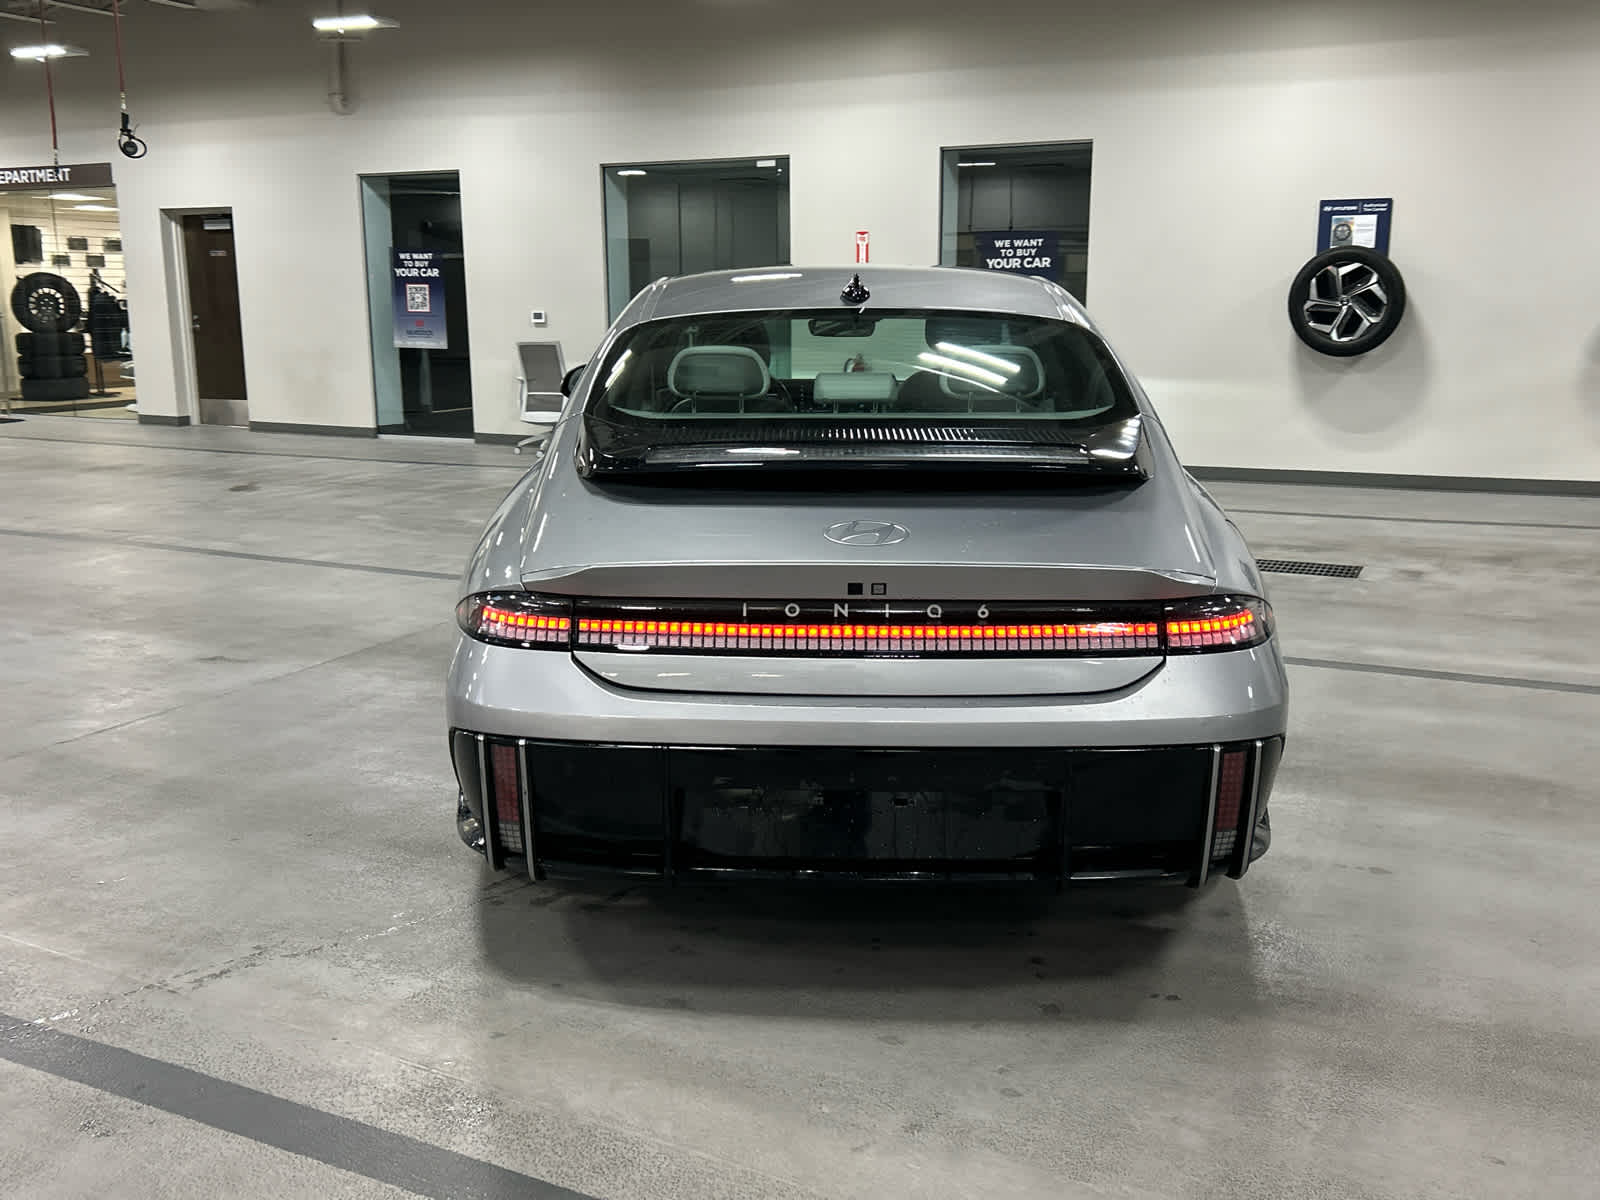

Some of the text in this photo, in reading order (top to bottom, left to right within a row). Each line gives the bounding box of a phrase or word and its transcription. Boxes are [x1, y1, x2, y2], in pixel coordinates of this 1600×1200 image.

[994, 238, 1044, 248] WE WANT
[1000, 248, 1037, 257] TO BUY
[986, 257, 1052, 269] YOUR CAR
[394, 268, 440, 277] YOUR CAR
